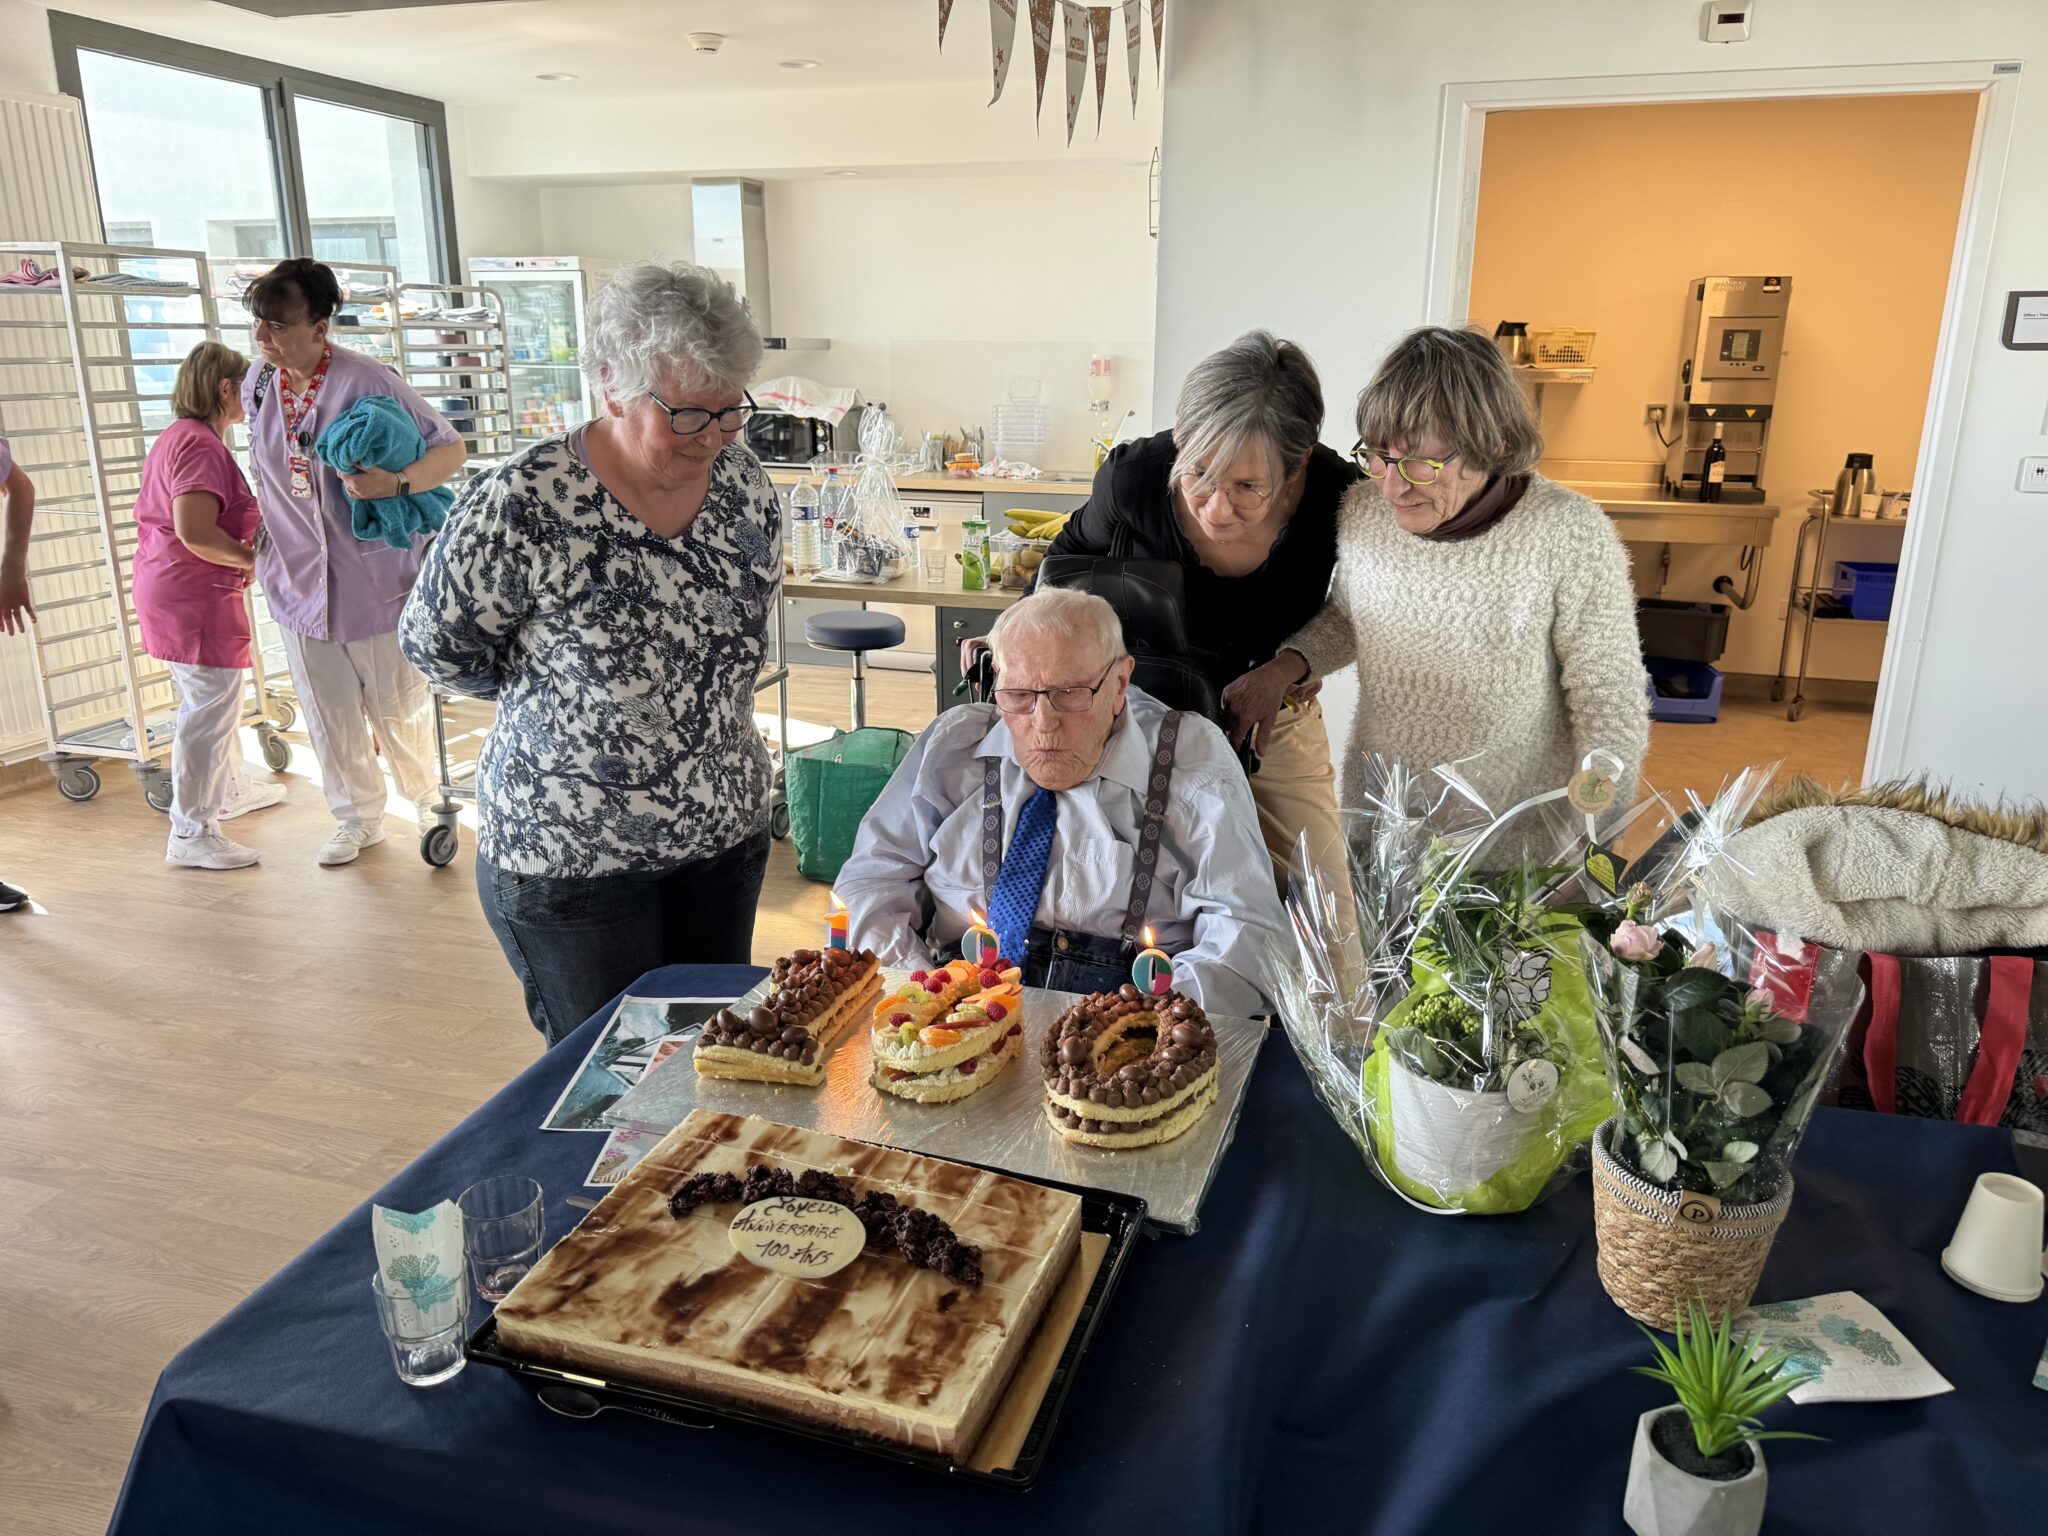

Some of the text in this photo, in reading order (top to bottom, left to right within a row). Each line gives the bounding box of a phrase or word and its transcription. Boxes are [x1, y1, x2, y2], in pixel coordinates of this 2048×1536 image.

[1692, 1208, 1705, 1219] P
[756, 1240, 834, 1266] 100 ANS
